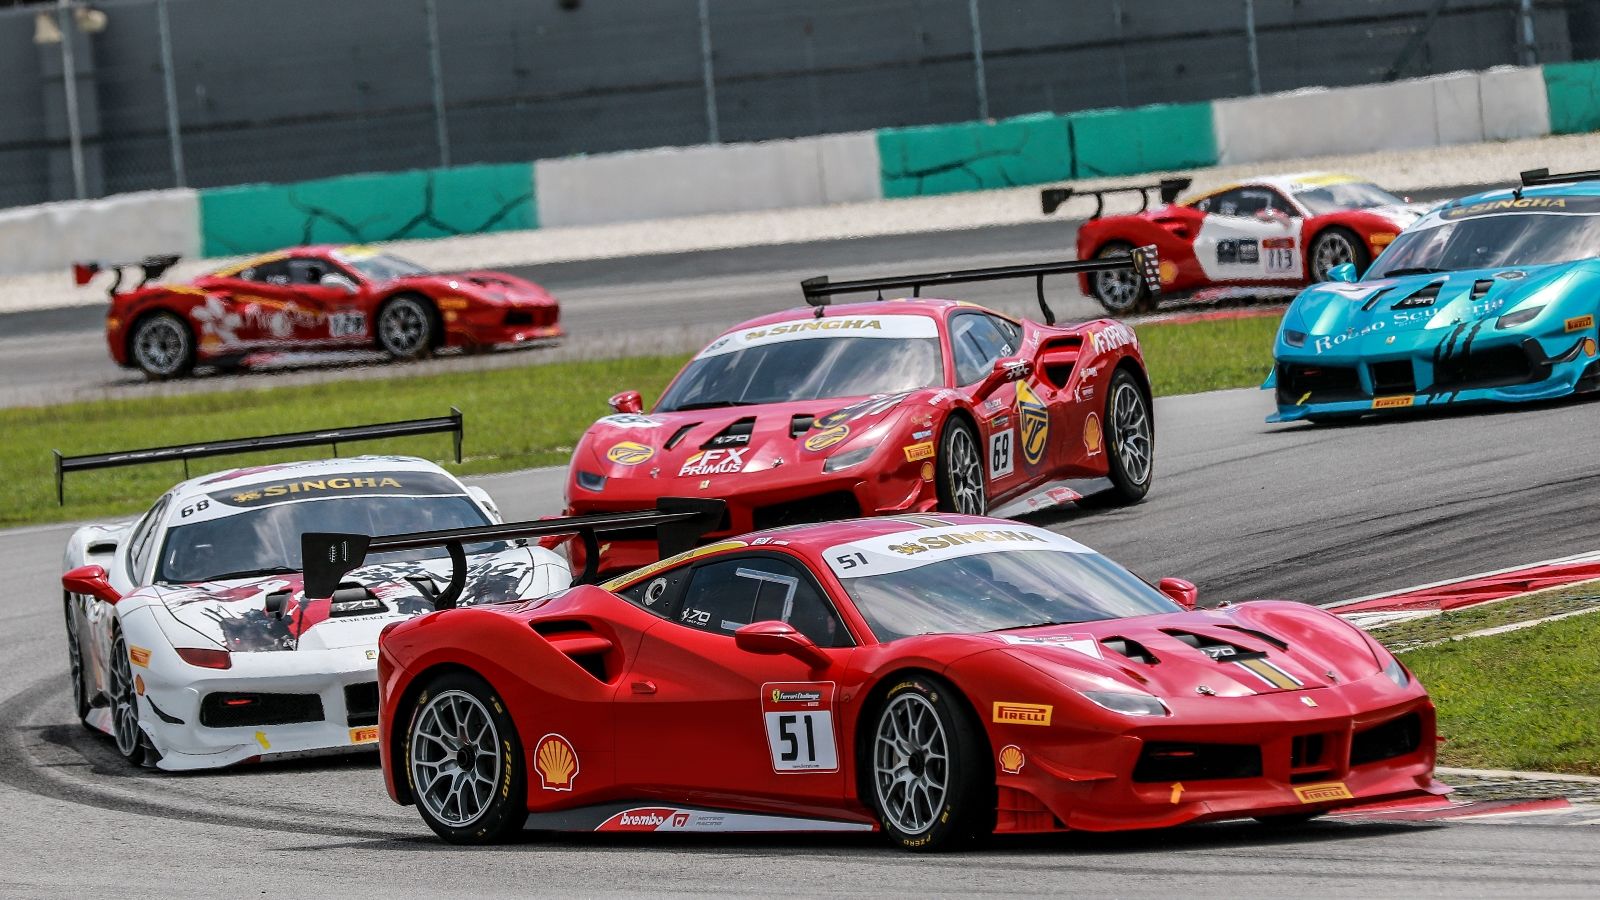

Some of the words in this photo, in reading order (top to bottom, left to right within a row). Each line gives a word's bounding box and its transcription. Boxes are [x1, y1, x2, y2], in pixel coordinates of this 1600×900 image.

[1469, 198, 1567, 213] SINGHA
[767, 320, 882, 336] SINGHA
[725, 434, 750, 443] 70
[699, 447, 751, 467] FX
[993, 433, 1009, 472] 69
[679, 463, 742, 477] PRIMUS
[262, 477, 403, 497] SINGHA
[180, 499, 209, 518] 68
[917, 530, 1048, 550] SINGHA
[836, 552, 868, 570] 51
[348, 599, 379, 610] 70
[688, 609, 711, 622] 70
[780, 692, 798, 700] Ferrari
[798, 692, 820, 701] Challenge
[998, 705, 1047, 722] PIRELLI
[779, 715, 816, 761] 51
[1300, 786, 1346, 801] PIRELLI
[620, 812, 664, 826] brembo
